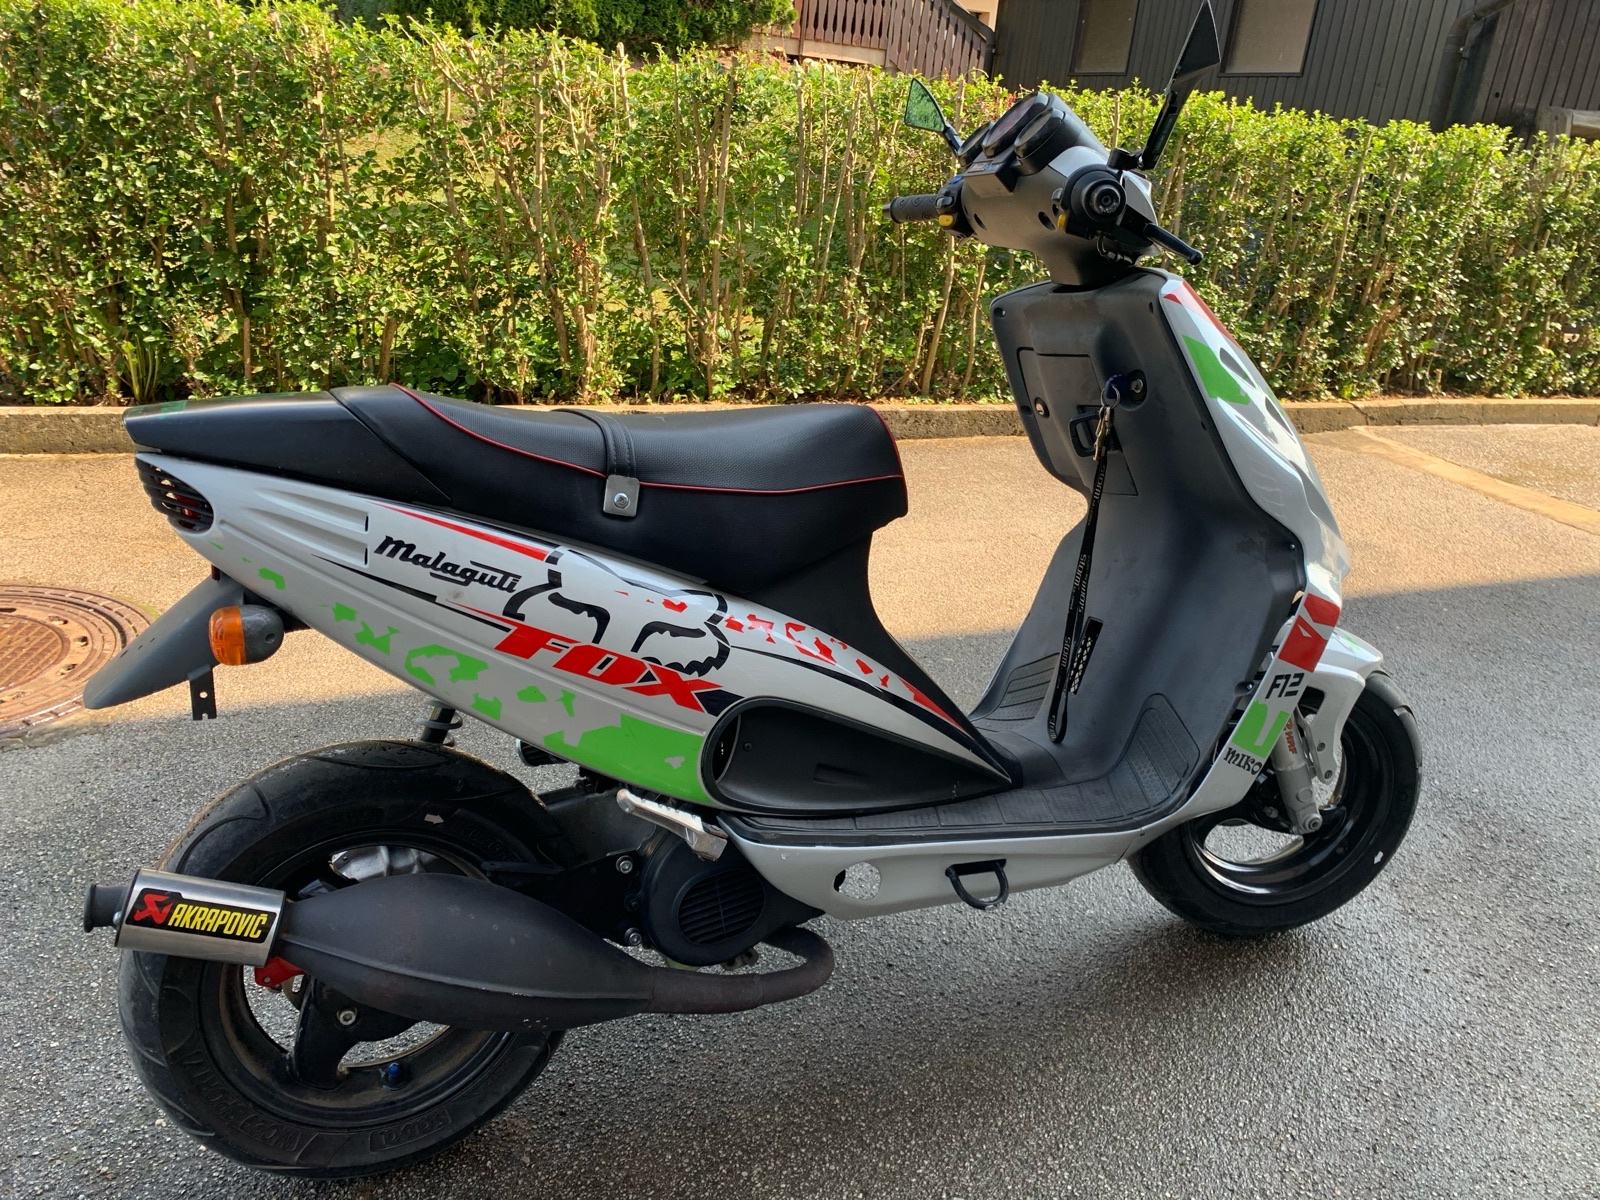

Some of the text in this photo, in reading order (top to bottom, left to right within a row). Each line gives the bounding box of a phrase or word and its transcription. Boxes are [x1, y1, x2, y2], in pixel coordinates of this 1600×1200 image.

[373, 535, 522, 593] Malaguti
[494, 622, 723, 713] FOX
[1265, 672, 1305, 699] F12
